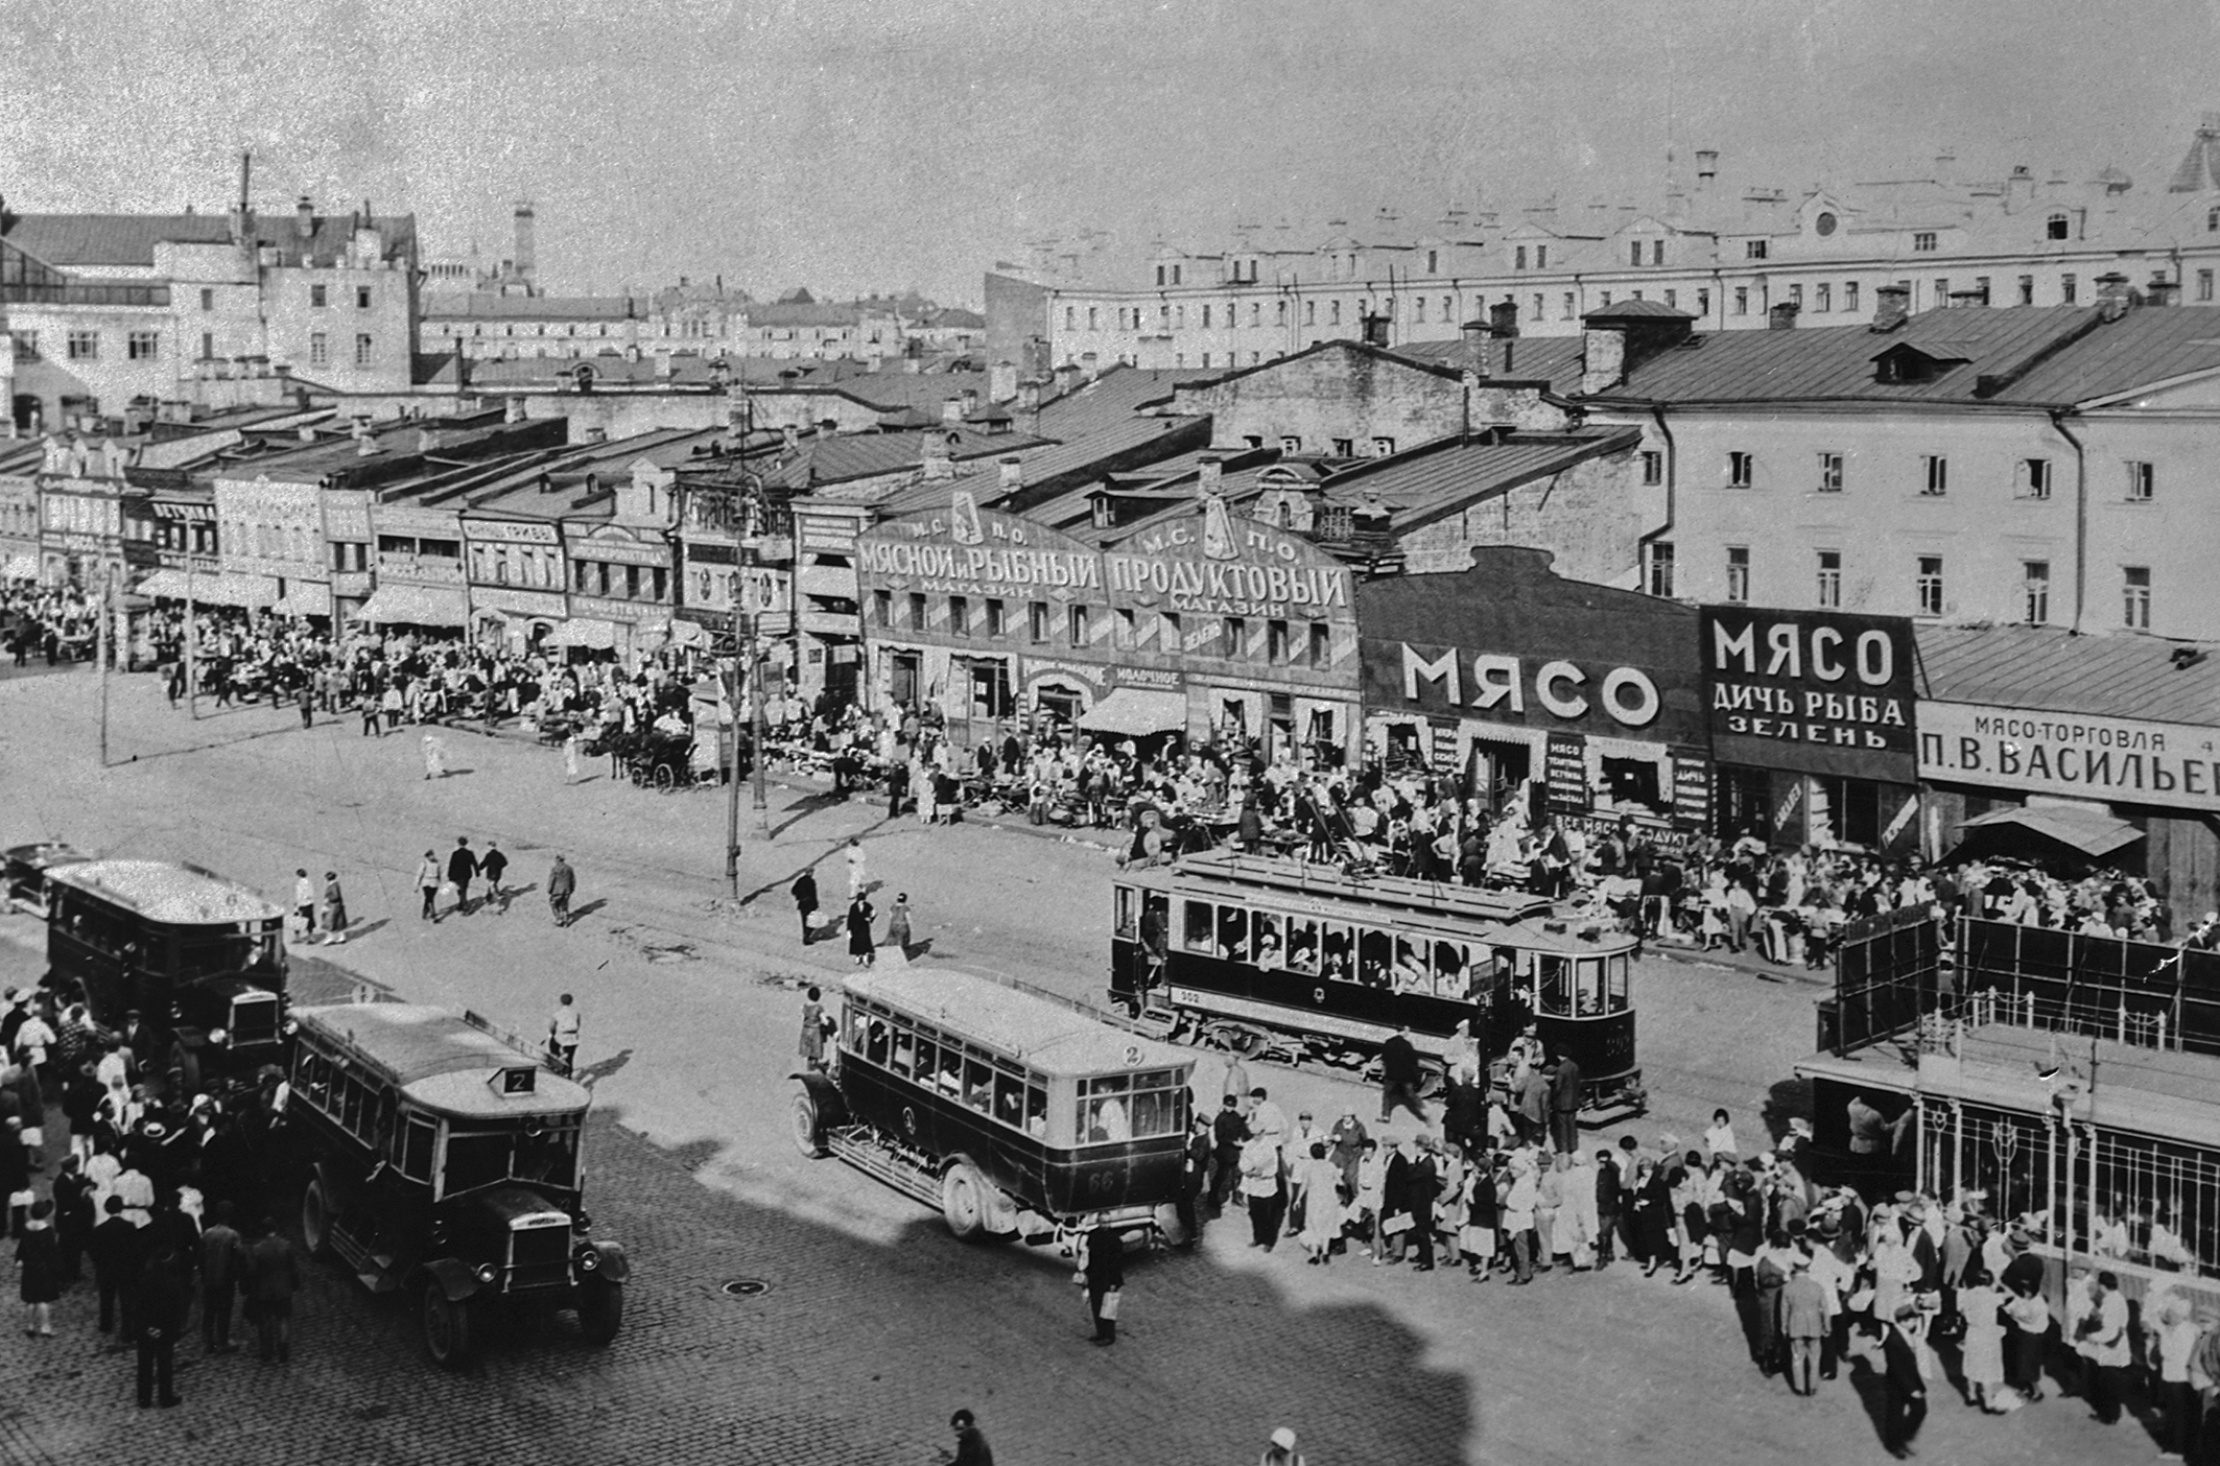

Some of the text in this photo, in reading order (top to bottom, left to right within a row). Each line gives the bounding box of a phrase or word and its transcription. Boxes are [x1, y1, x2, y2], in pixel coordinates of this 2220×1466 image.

[858, 541, 955, 579] МЯСНОЙ
[966, 548, 1101, 589] РЫБНЫЙ
[920, 580, 1034, 599] МАГАЗИН
[1112, 556, 1348, 608] ПРОДУКТОВЫЙ
[1170, 597, 1286, 618] МАГАЗИН
[1713, 618, 1893, 686] МЯСО
[1116, 667, 1180, 685] МОЛОЧНОЕ
[1402, 641, 1659, 726] МЯСО
[1713, 682, 1906, 727] ДИЧЬ РЫБА
[1728, 715, 1888, 749] ЗЕЛЕНЬ
[1975, 716, 2165, 751] МЯСО-ТОРГОВЛЯ
[1550, 743, 1580, 756] МЯСО
[1126, 1046, 1139, 1064] 2
[512, 1073, 526, 1091] 2
[1089, 1170, 1115, 1192] 66
